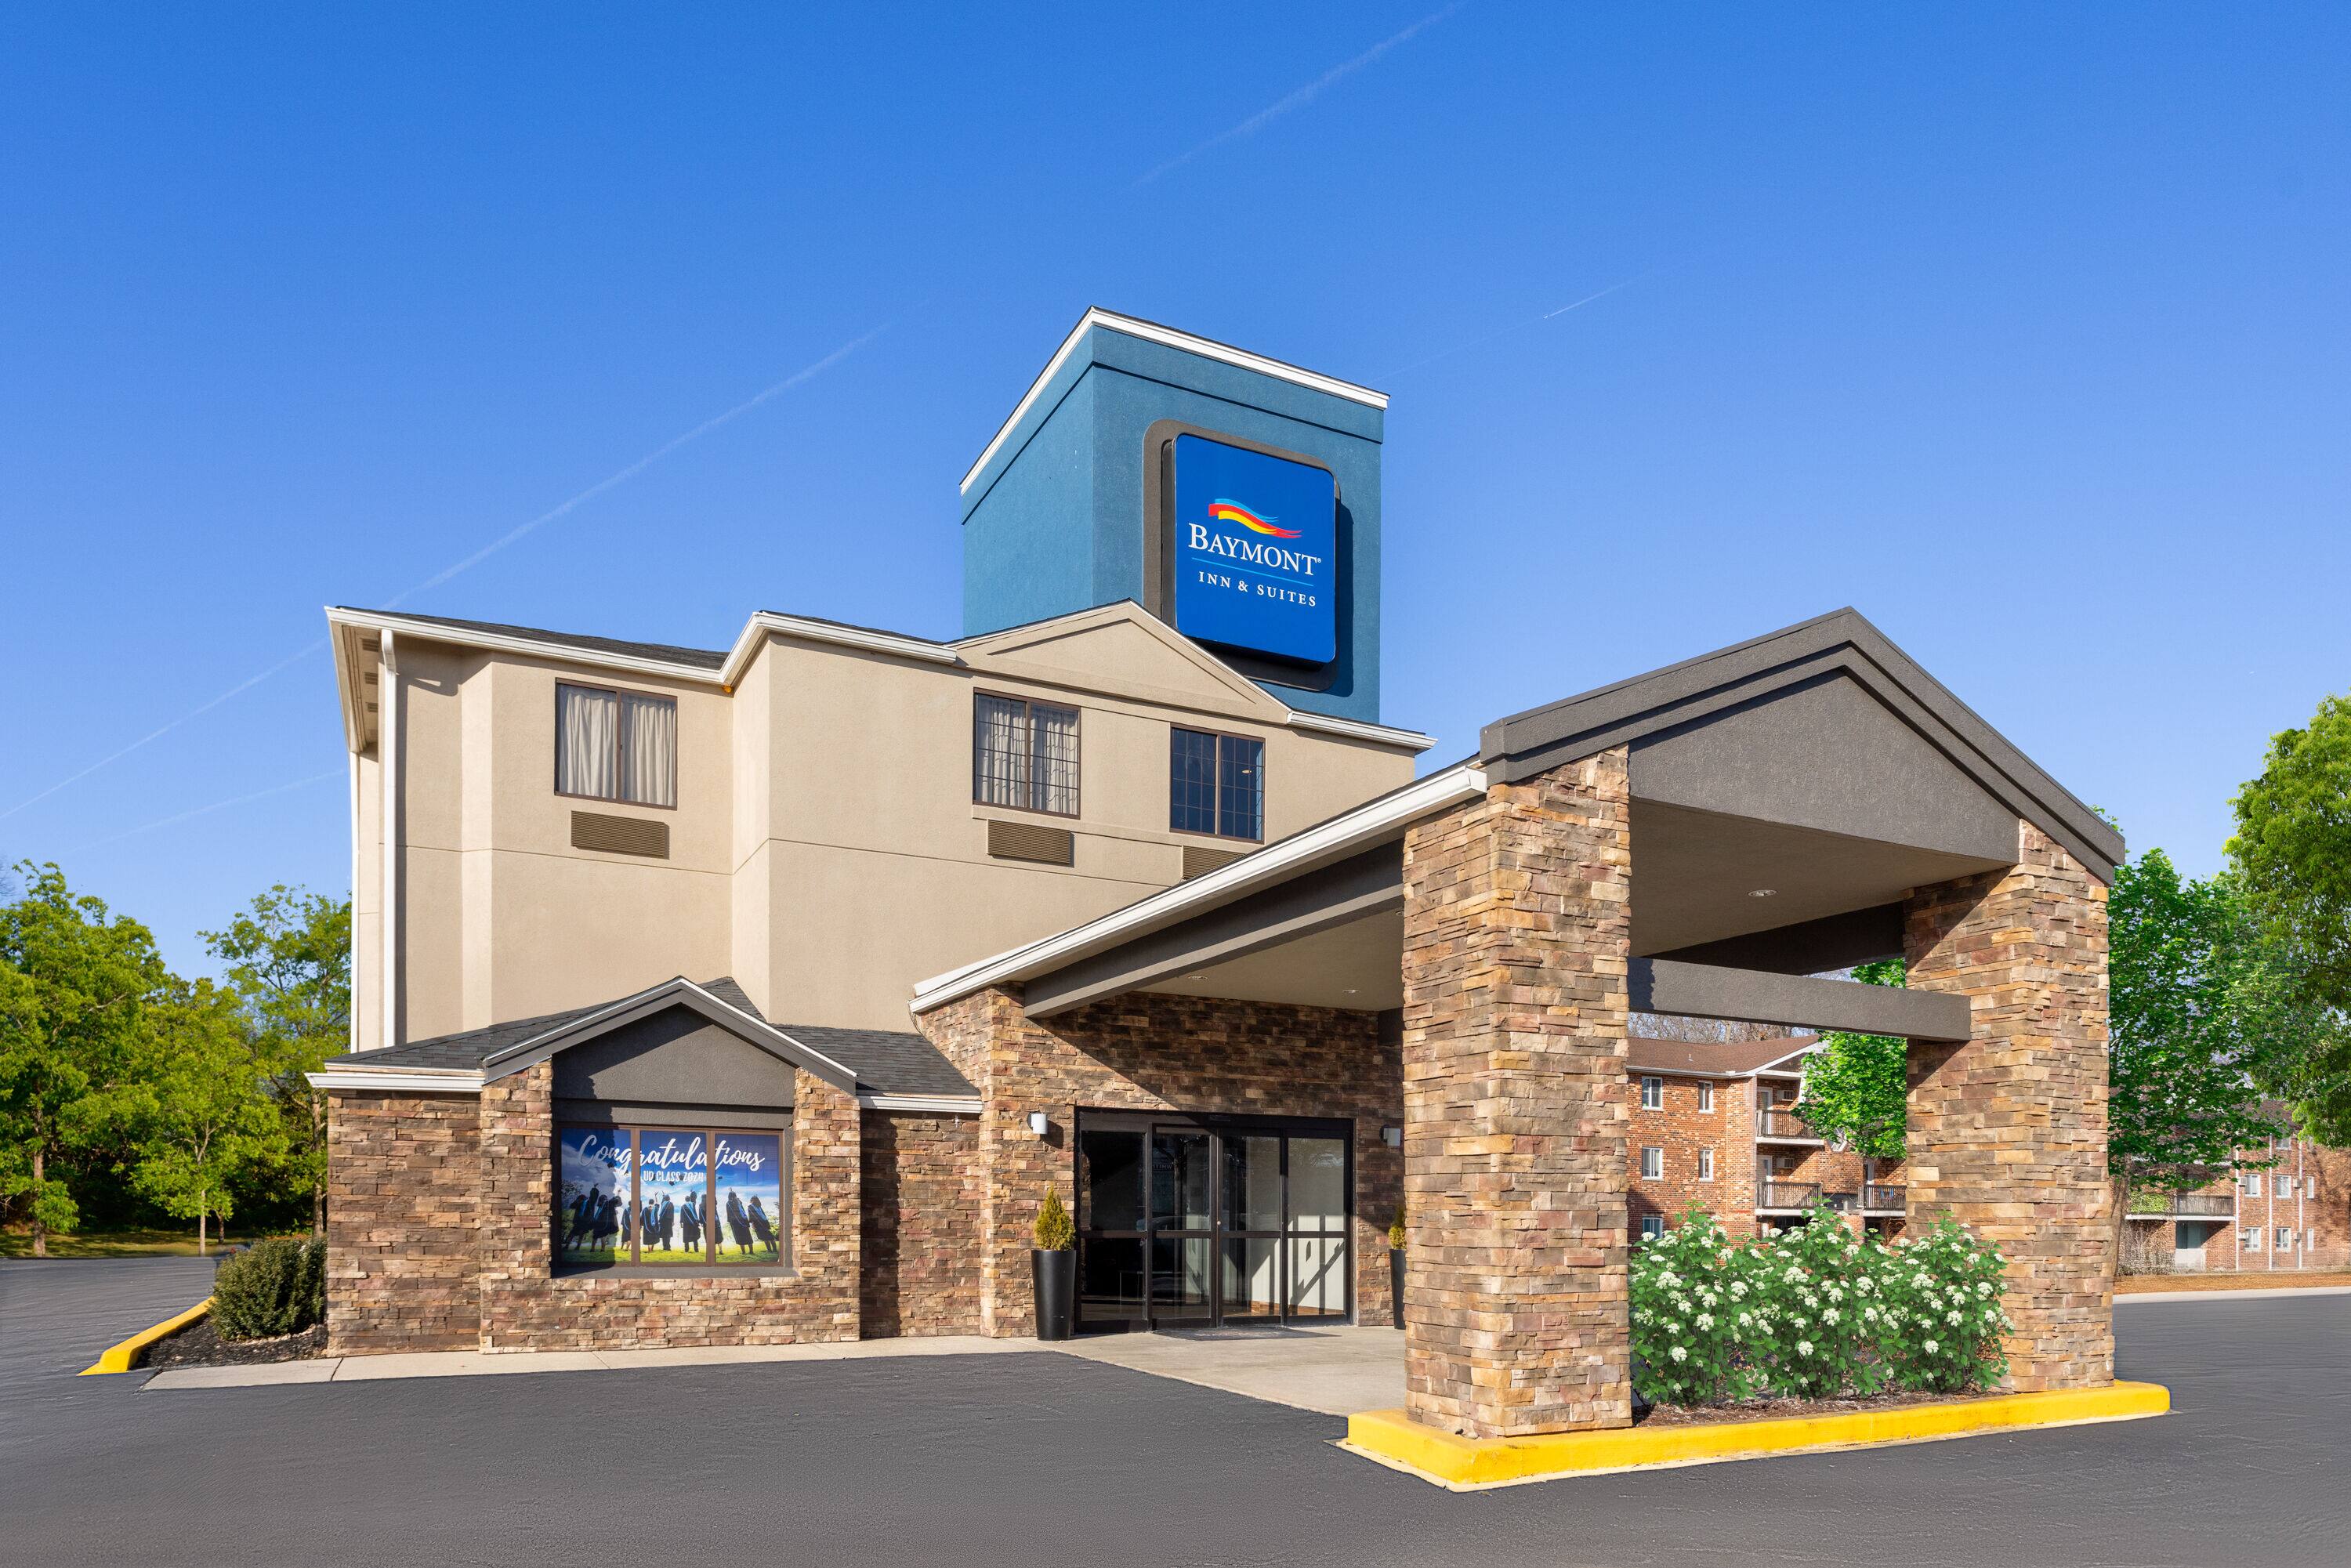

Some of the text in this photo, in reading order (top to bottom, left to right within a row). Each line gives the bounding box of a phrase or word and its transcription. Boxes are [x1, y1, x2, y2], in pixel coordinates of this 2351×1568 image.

[1198, 570, 1316, 607] INN & SUITES
[643, 1170, 704, 1182] UD CLASS 2024
